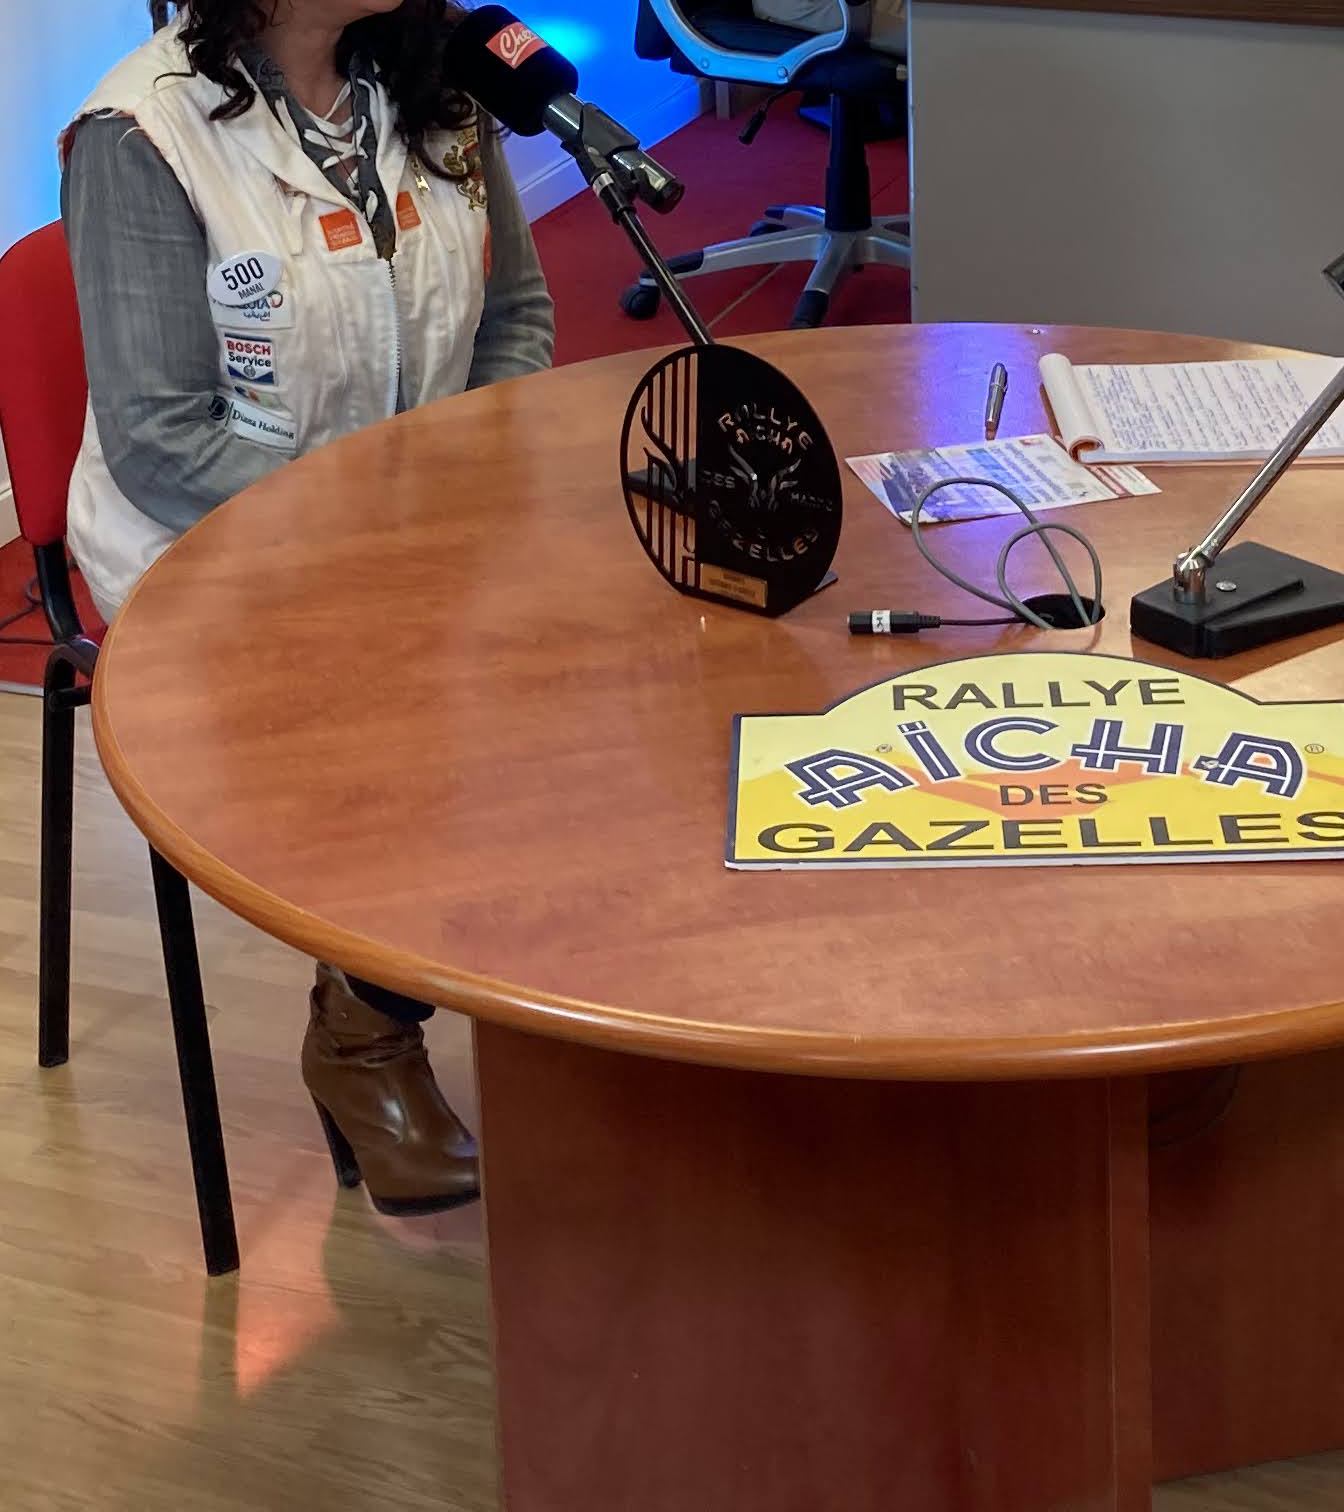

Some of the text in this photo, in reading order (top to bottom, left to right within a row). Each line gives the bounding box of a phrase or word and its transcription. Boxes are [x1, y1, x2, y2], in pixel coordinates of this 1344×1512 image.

[221, 257, 265, 290] 500
[226, 340, 271, 355] BOSCH
[228, 352, 271, 367] Service
[259, 421, 295, 440] Holding
[892, 677, 1185, 711] RALLYE
[1000, 783, 1108, 807] DES
